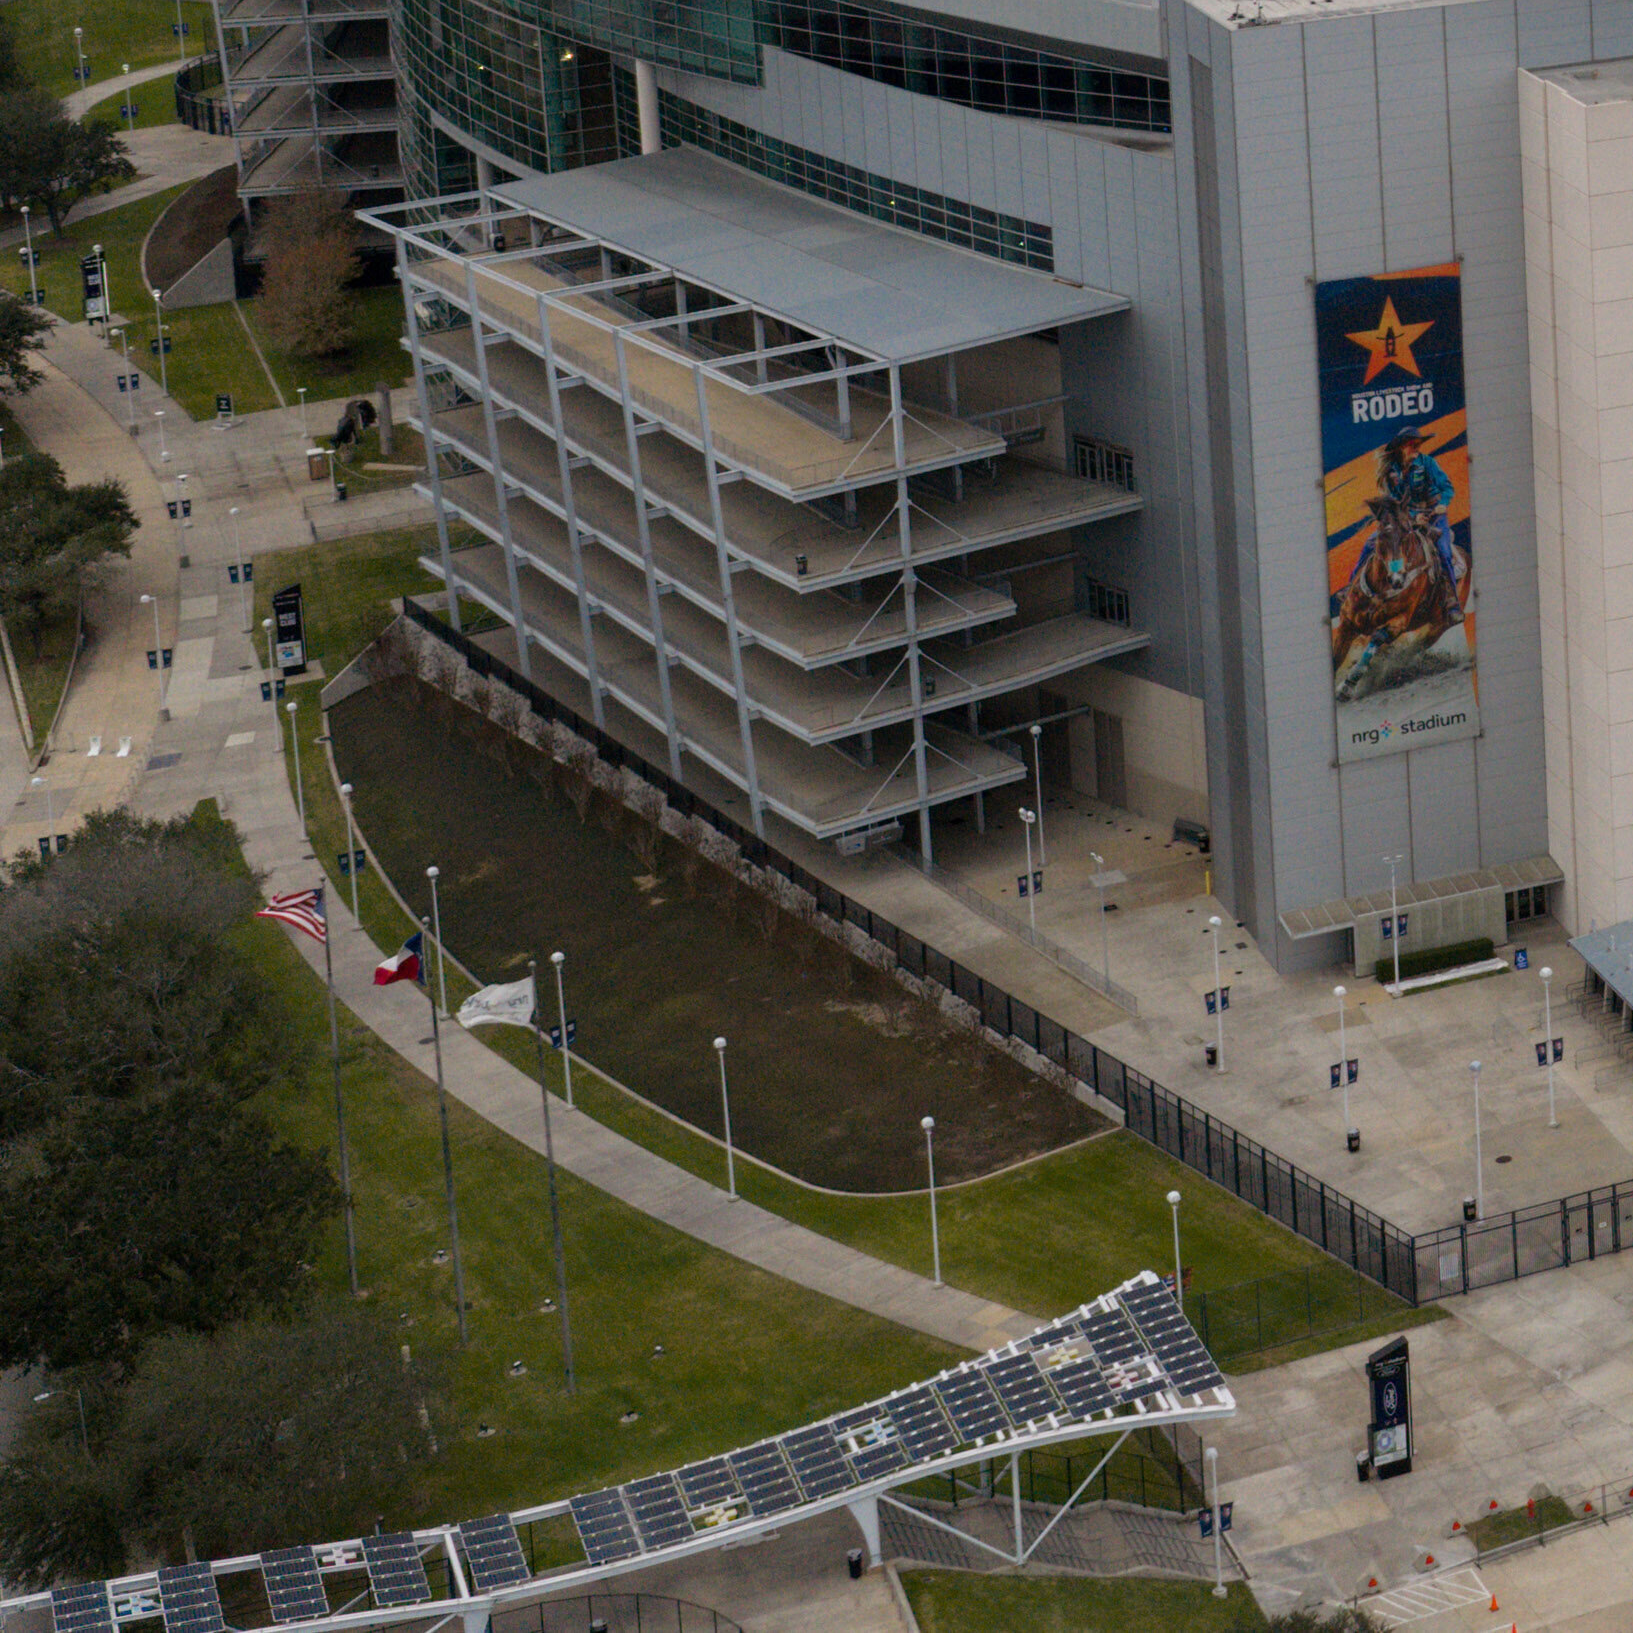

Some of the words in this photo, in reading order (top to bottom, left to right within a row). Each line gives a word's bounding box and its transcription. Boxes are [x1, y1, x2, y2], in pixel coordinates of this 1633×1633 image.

[1352, 389, 1434, 423] RODEO
[1351, 729, 1380, 745] nrg
[1400, 712, 1467, 735] stadium
